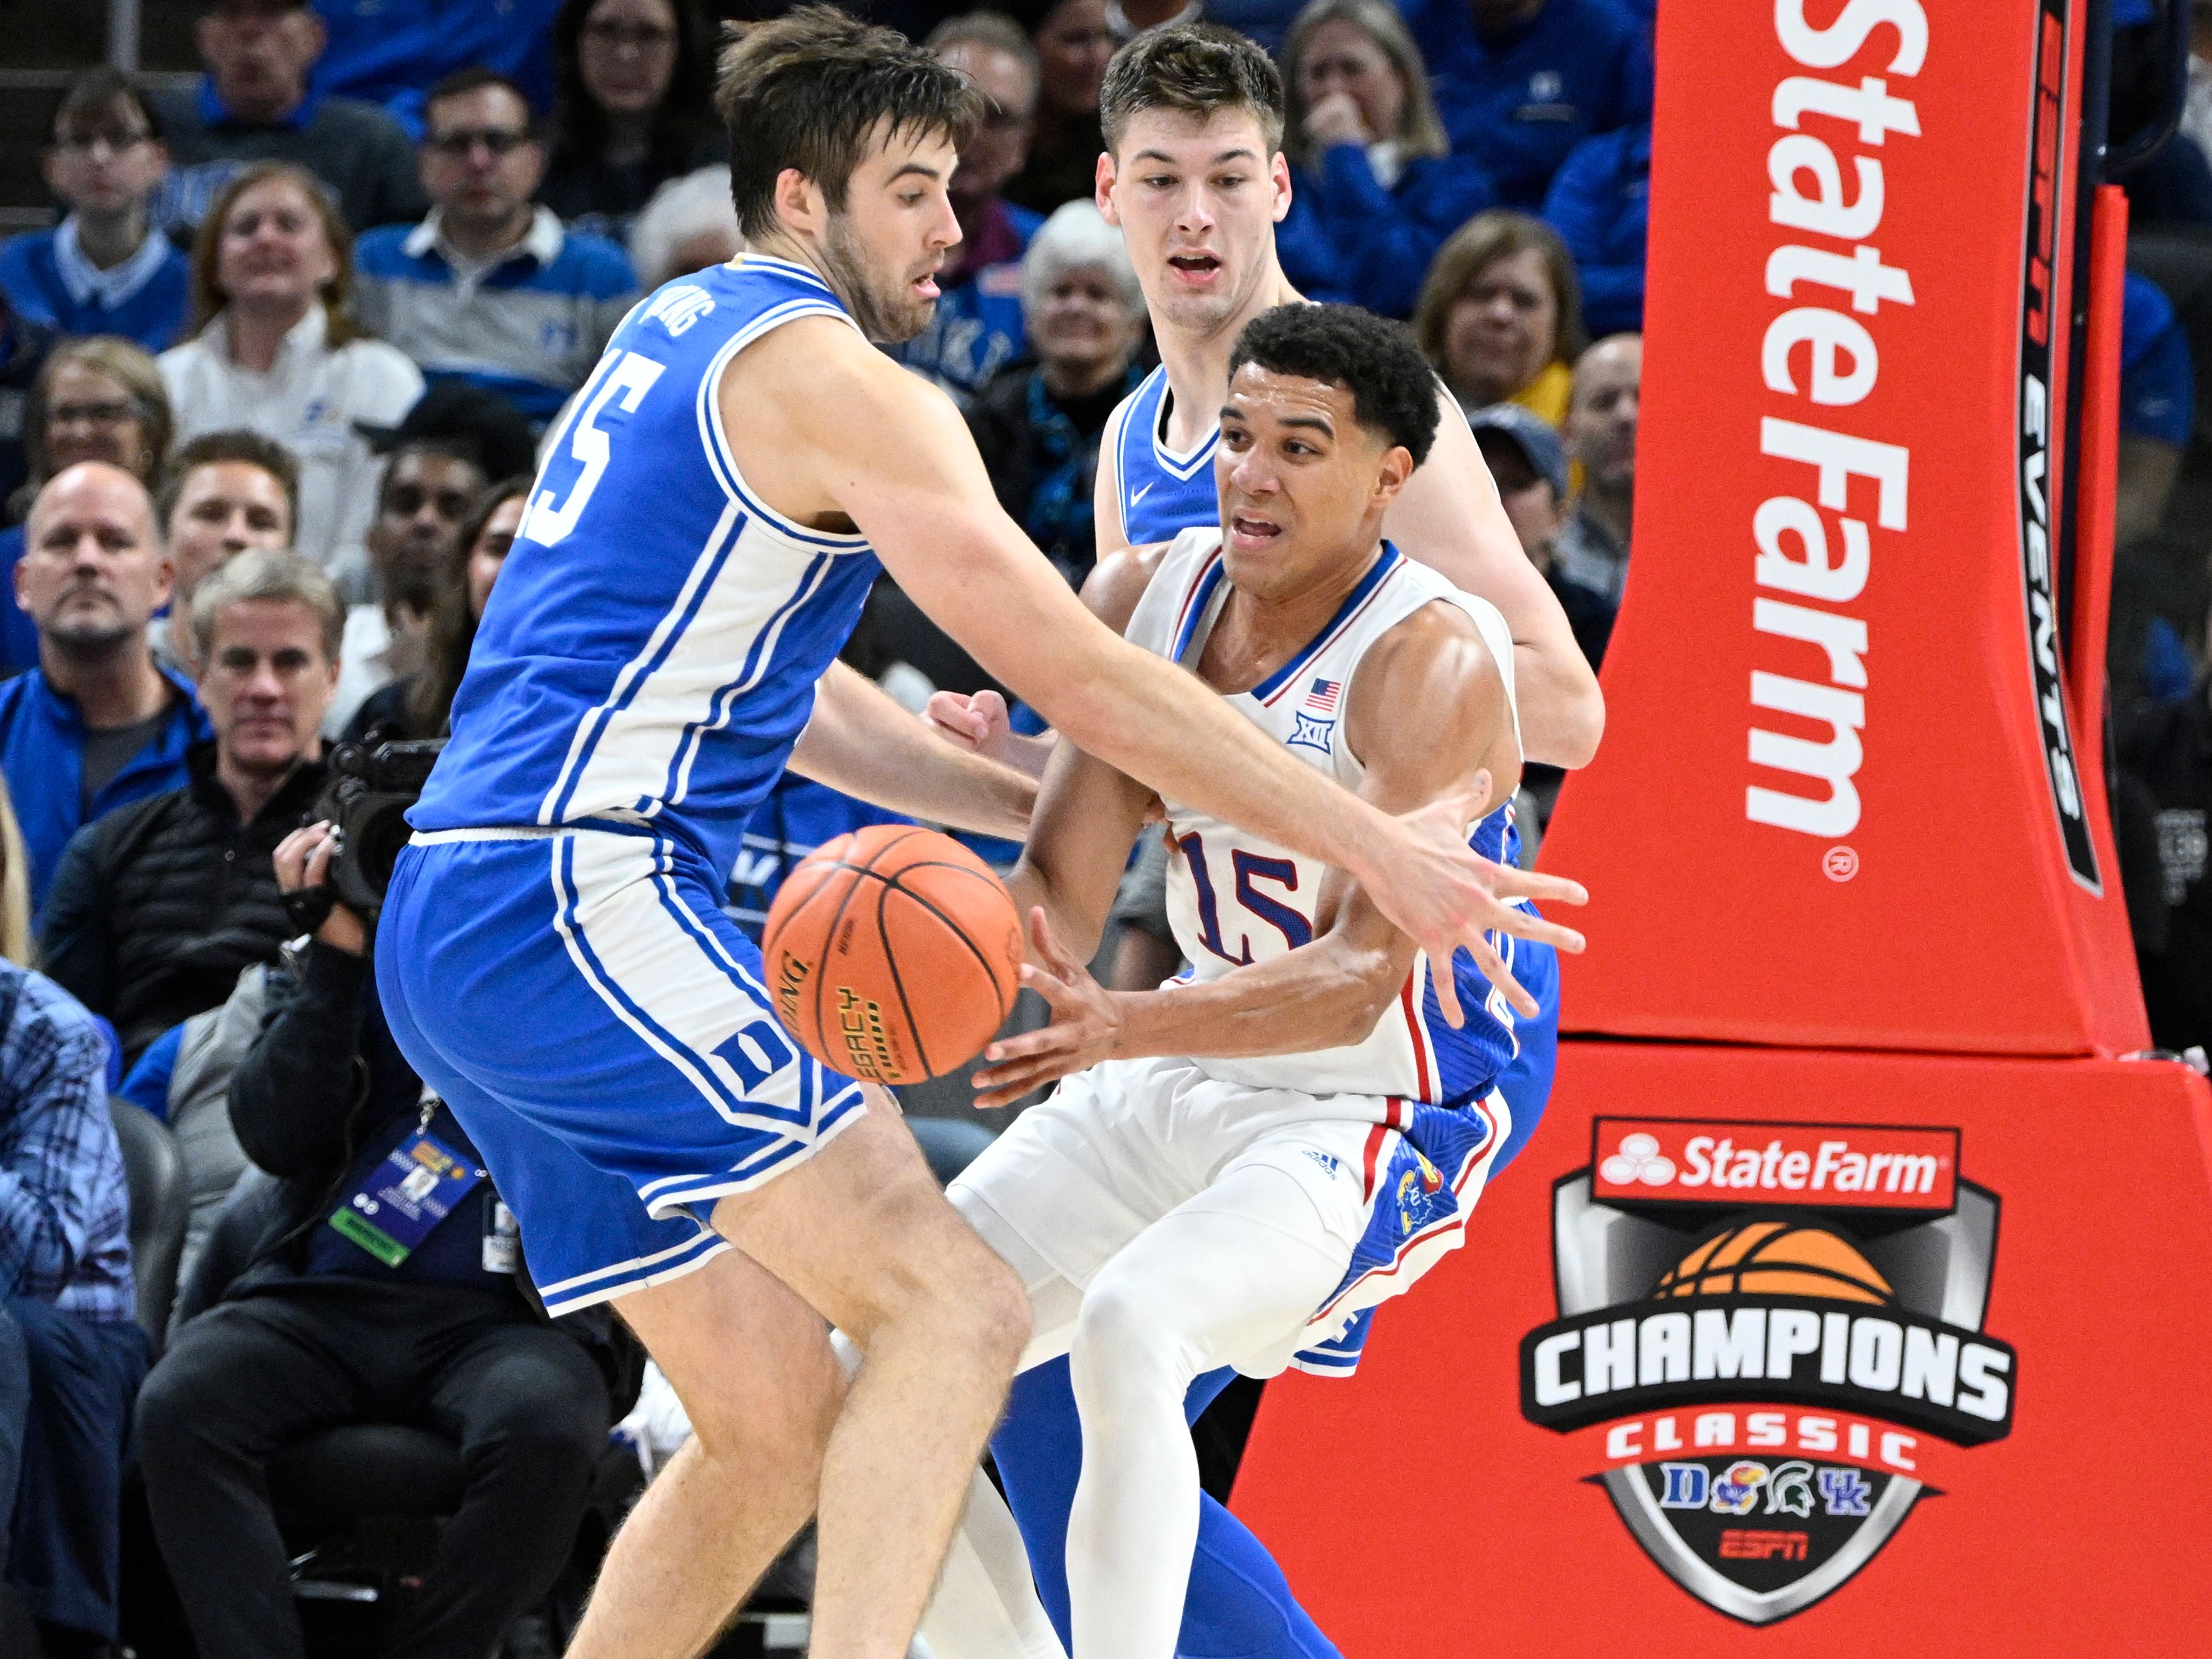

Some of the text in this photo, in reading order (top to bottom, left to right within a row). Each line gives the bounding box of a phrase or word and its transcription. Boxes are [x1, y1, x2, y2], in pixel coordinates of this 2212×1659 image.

[2024, 11, 2081, 820] ESPN EVENTS
[1178, 831, 1313, 967] 15
[1302, 1150, 1337, 1181] adidas
[1534, 1308, 2010, 1422] CHAMPIONS
[1606, 1413, 1917, 1471] CLASSIC
[1719, 1528, 1809, 1561] ESPN
